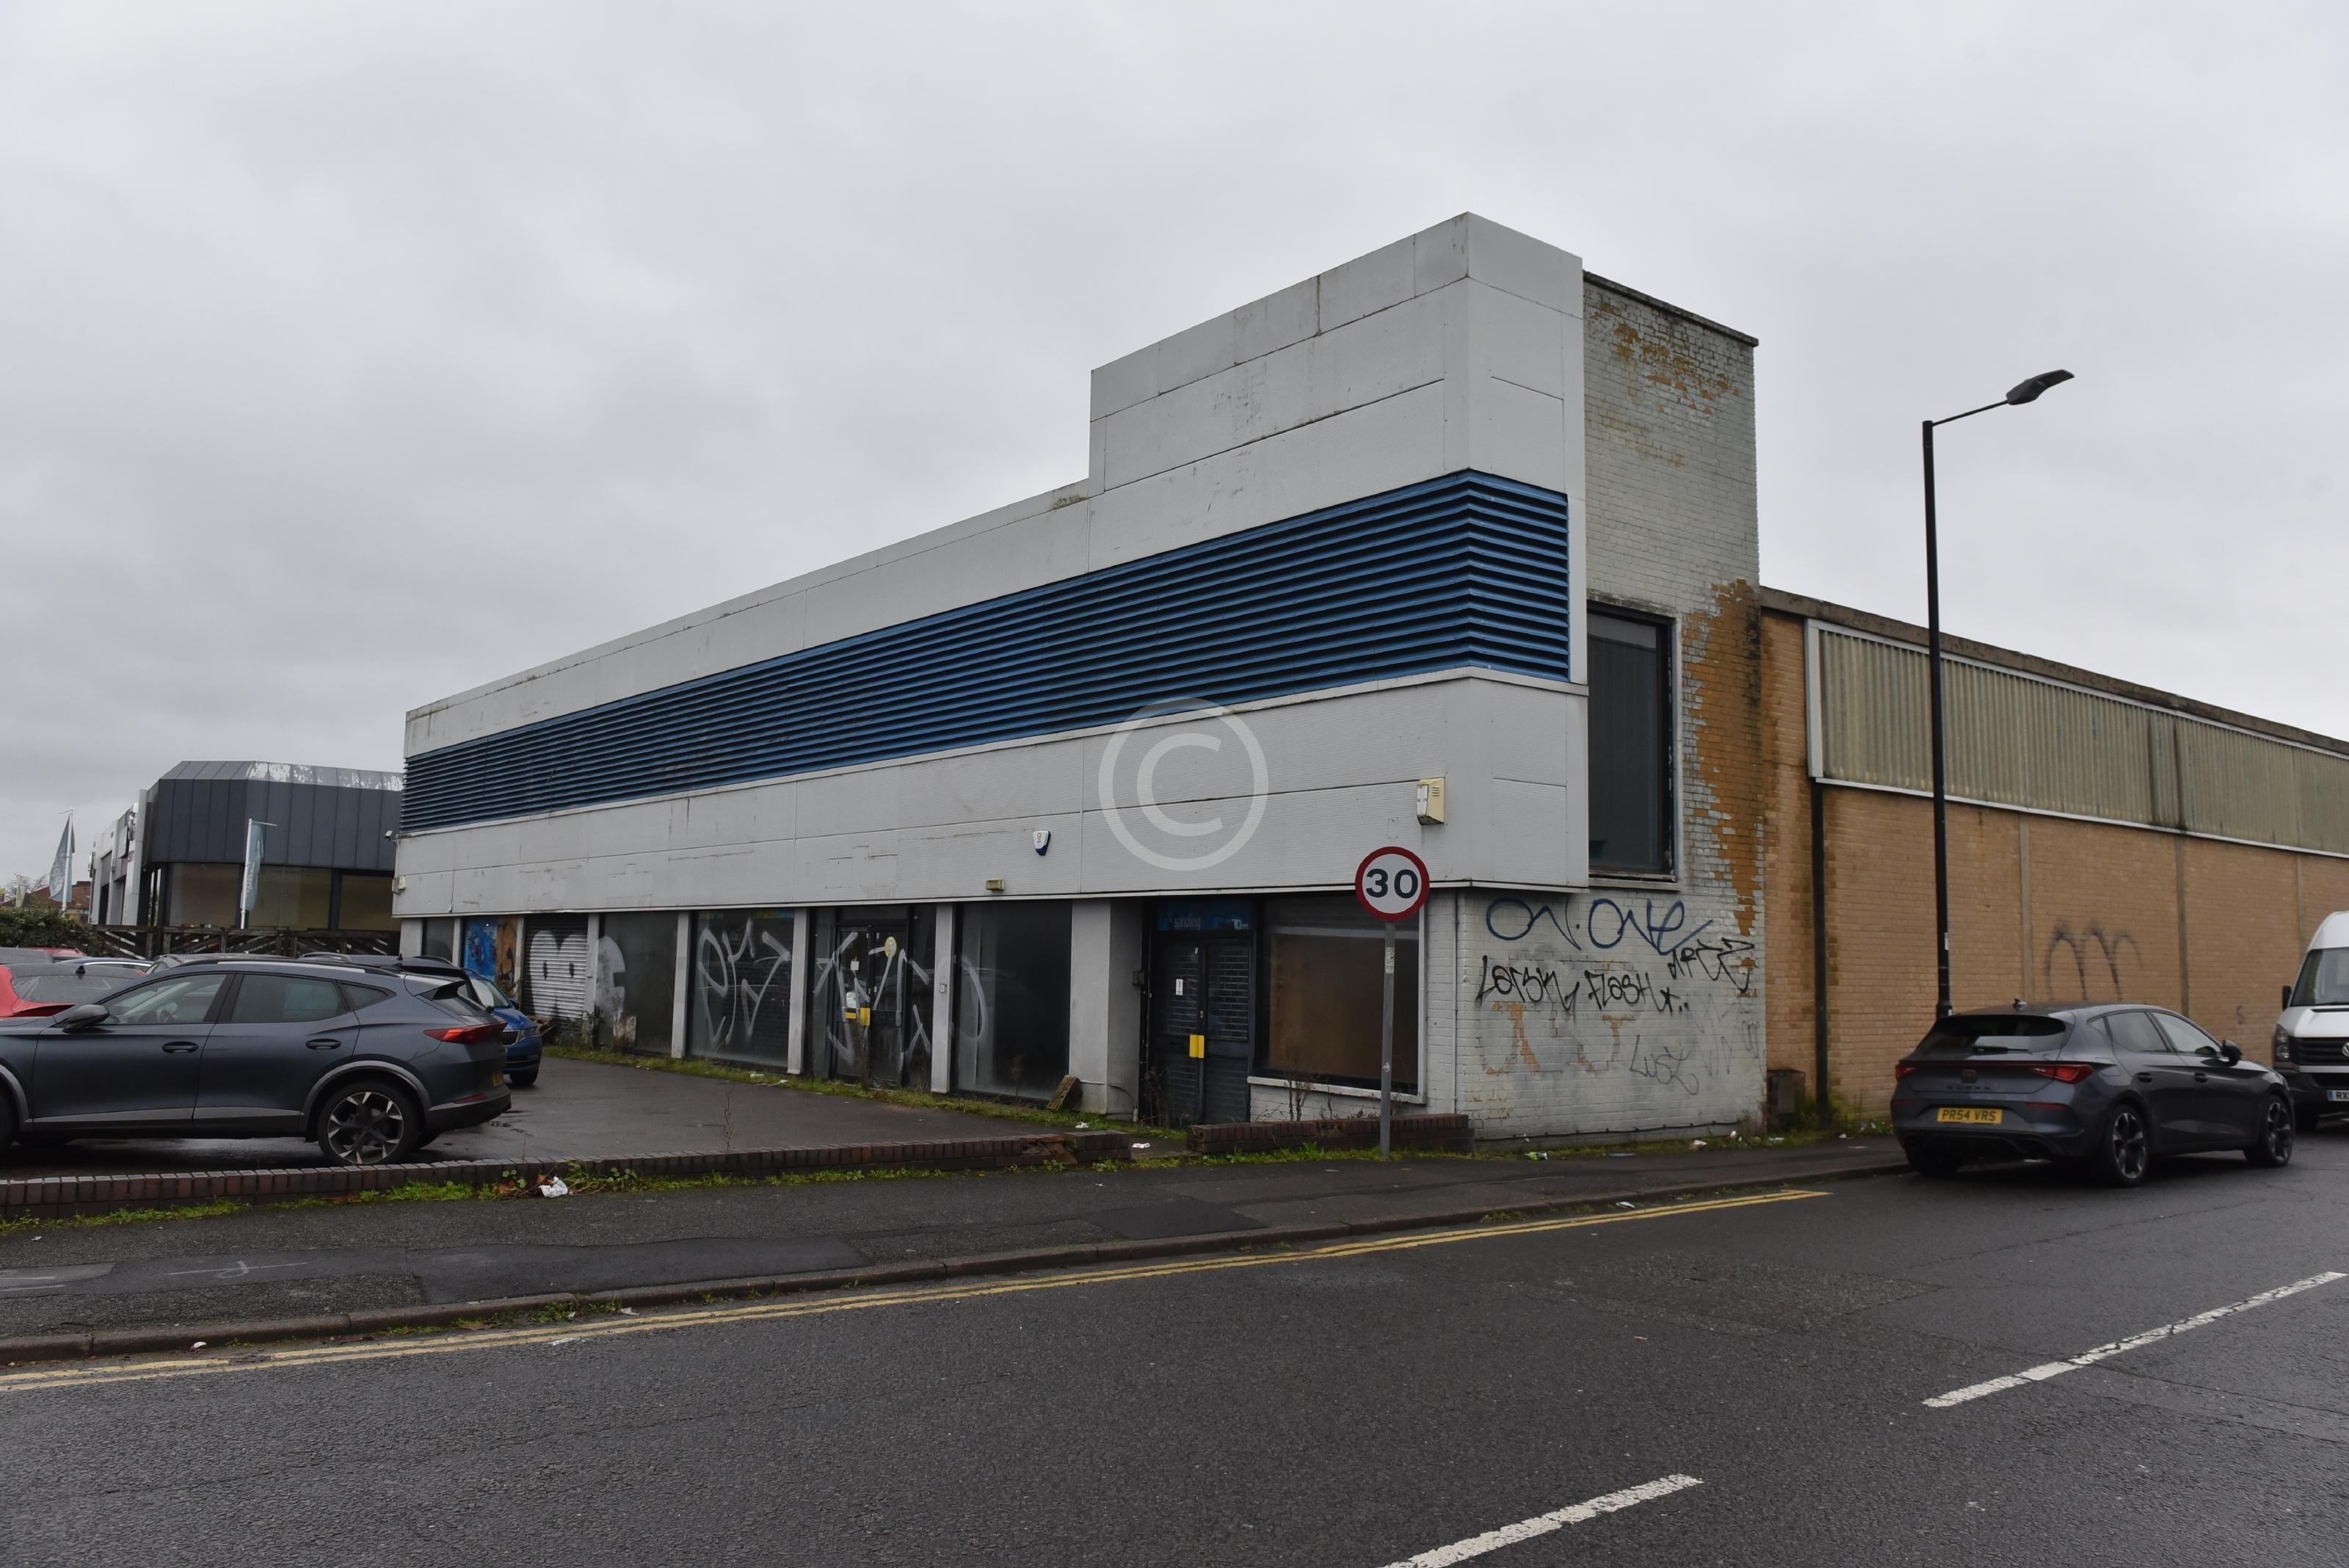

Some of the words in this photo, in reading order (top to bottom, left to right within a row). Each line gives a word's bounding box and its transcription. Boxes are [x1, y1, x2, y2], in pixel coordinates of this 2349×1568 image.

[1366, 868, 1418, 899] 30
[1942, 1109, 1971, 1121] PR54
[1975, 1110, 1996, 1122] VRS
